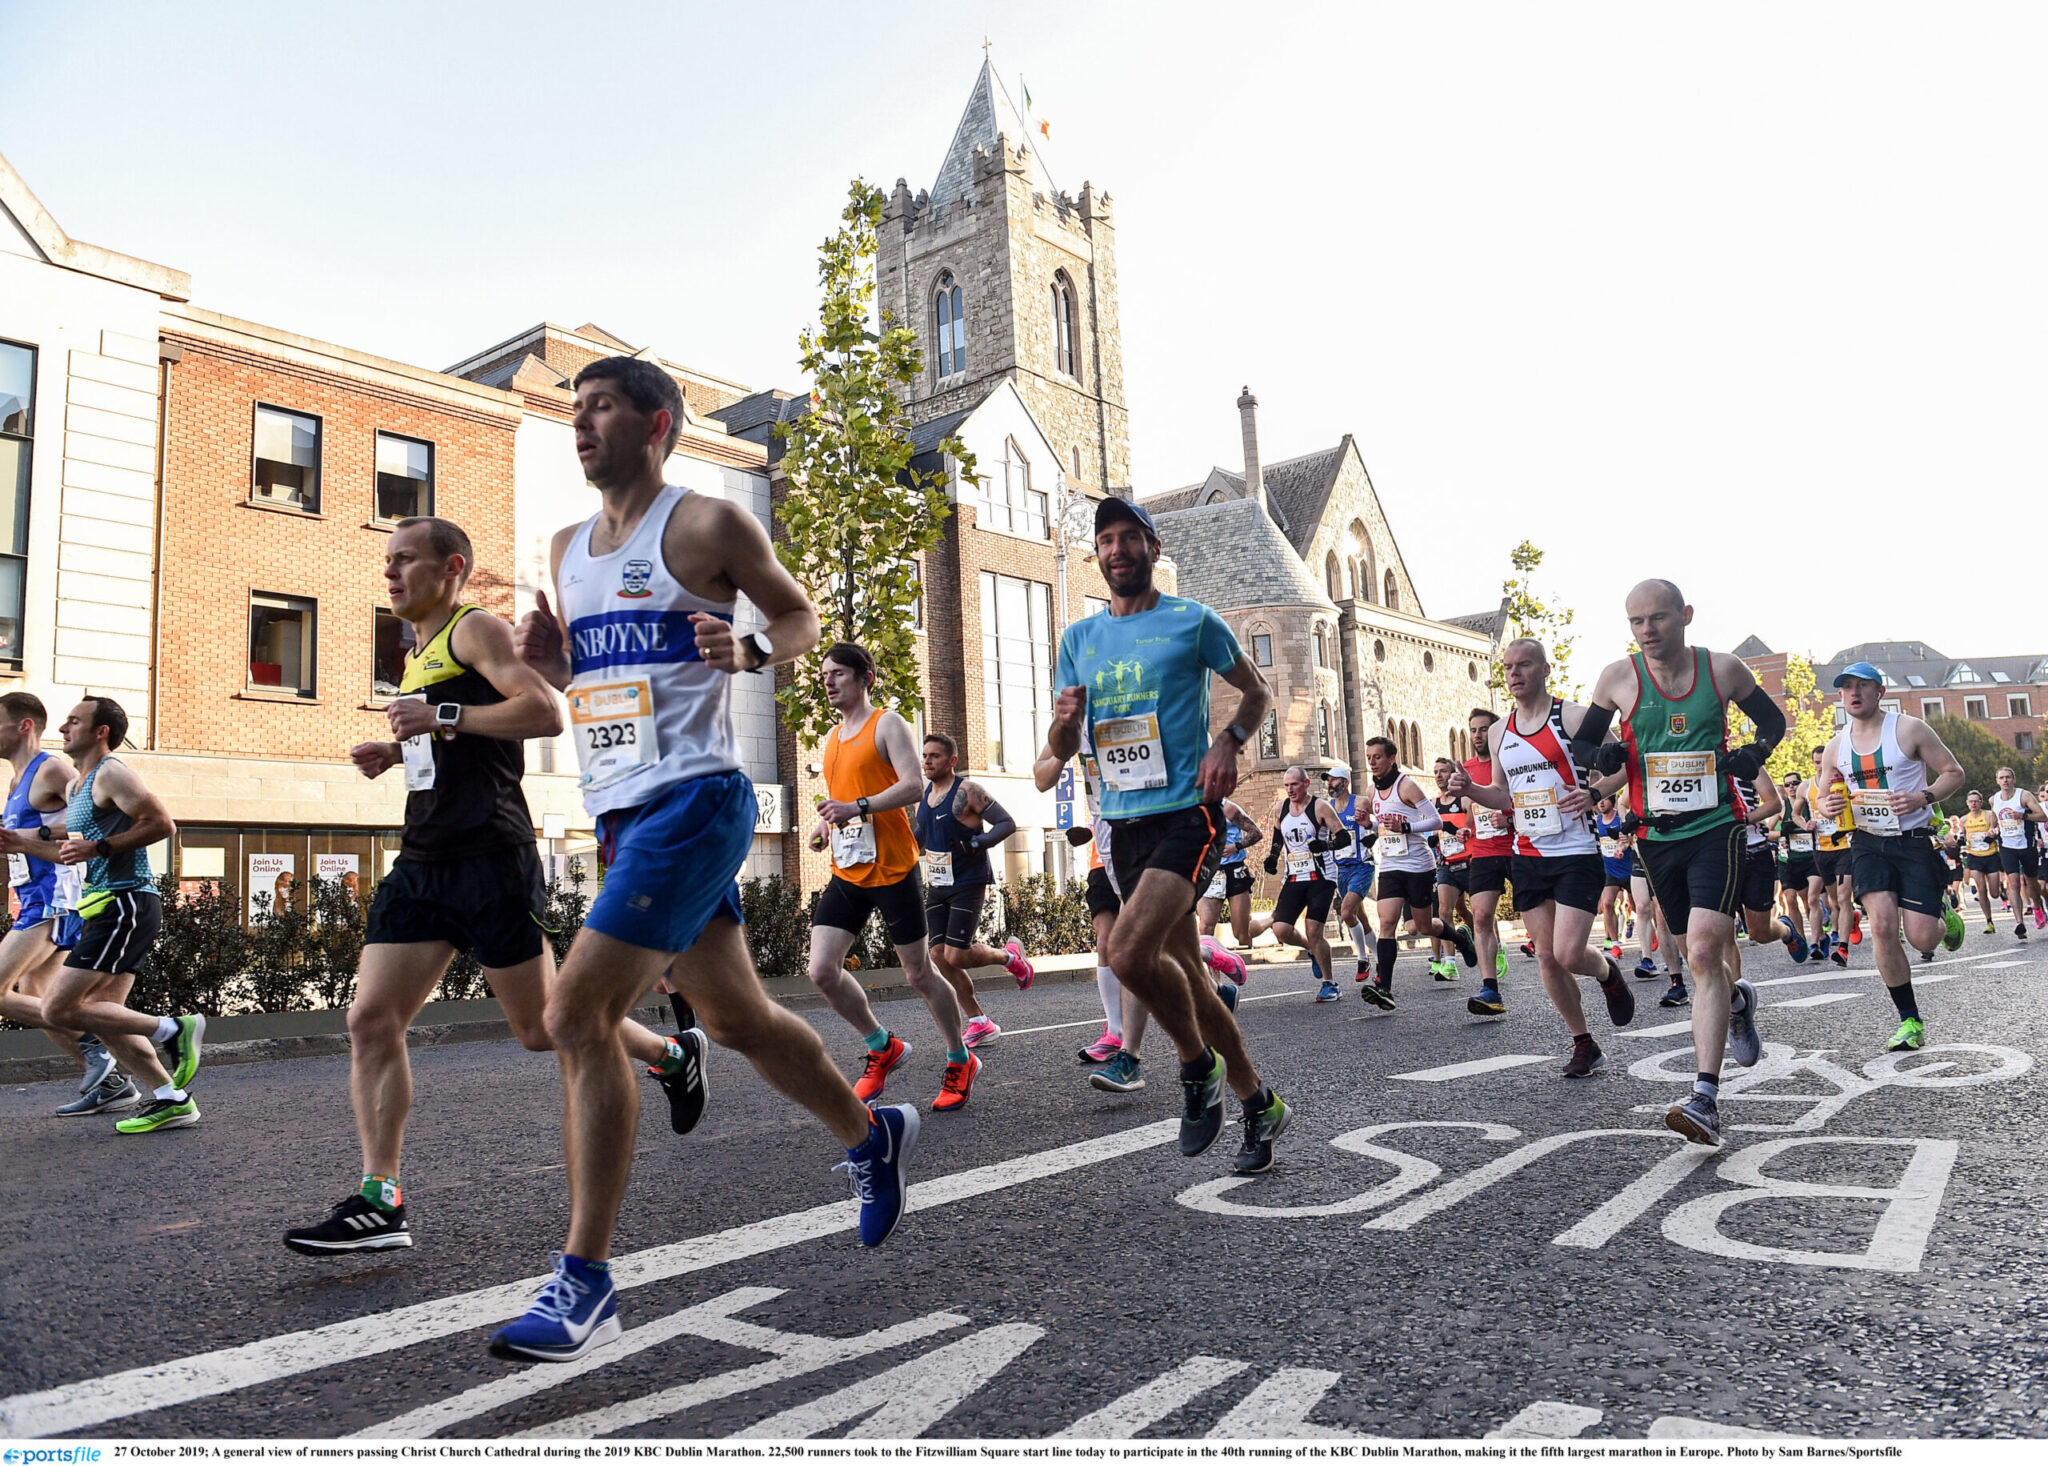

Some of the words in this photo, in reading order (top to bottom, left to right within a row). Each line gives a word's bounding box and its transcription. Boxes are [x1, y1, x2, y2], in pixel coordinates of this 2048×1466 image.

[571, 622, 668, 661] NBOYNE
[1126, 690, 1159, 702] RUNNERS
[587, 722, 636, 749] 2323
[1106, 744, 1150, 764] 4360
[1670, 760, 1705, 768] DUBLIN
[1058, 769, 1070, 790] P
[1526, 774, 1536, 784] AC
[1660, 778, 1702, 794] 2651
[1060, 803, 1069, 817] P
[1524, 808, 1547, 820] 882
[1860, 806, 1889, 817] 3430
[840, 826, 863, 840] 1627
[1384, 836, 1401, 844] 1386
[252, 858, 270, 866] Join
[271, 858, 283, 866] Us
[319, 858, 337, 866] Join
[337, 858, 349, 866] Us
[319, 864, 347, 872] Online
[252, 865, 281, 873] Online
[1176, 1119, 1961, 1274] BUS
